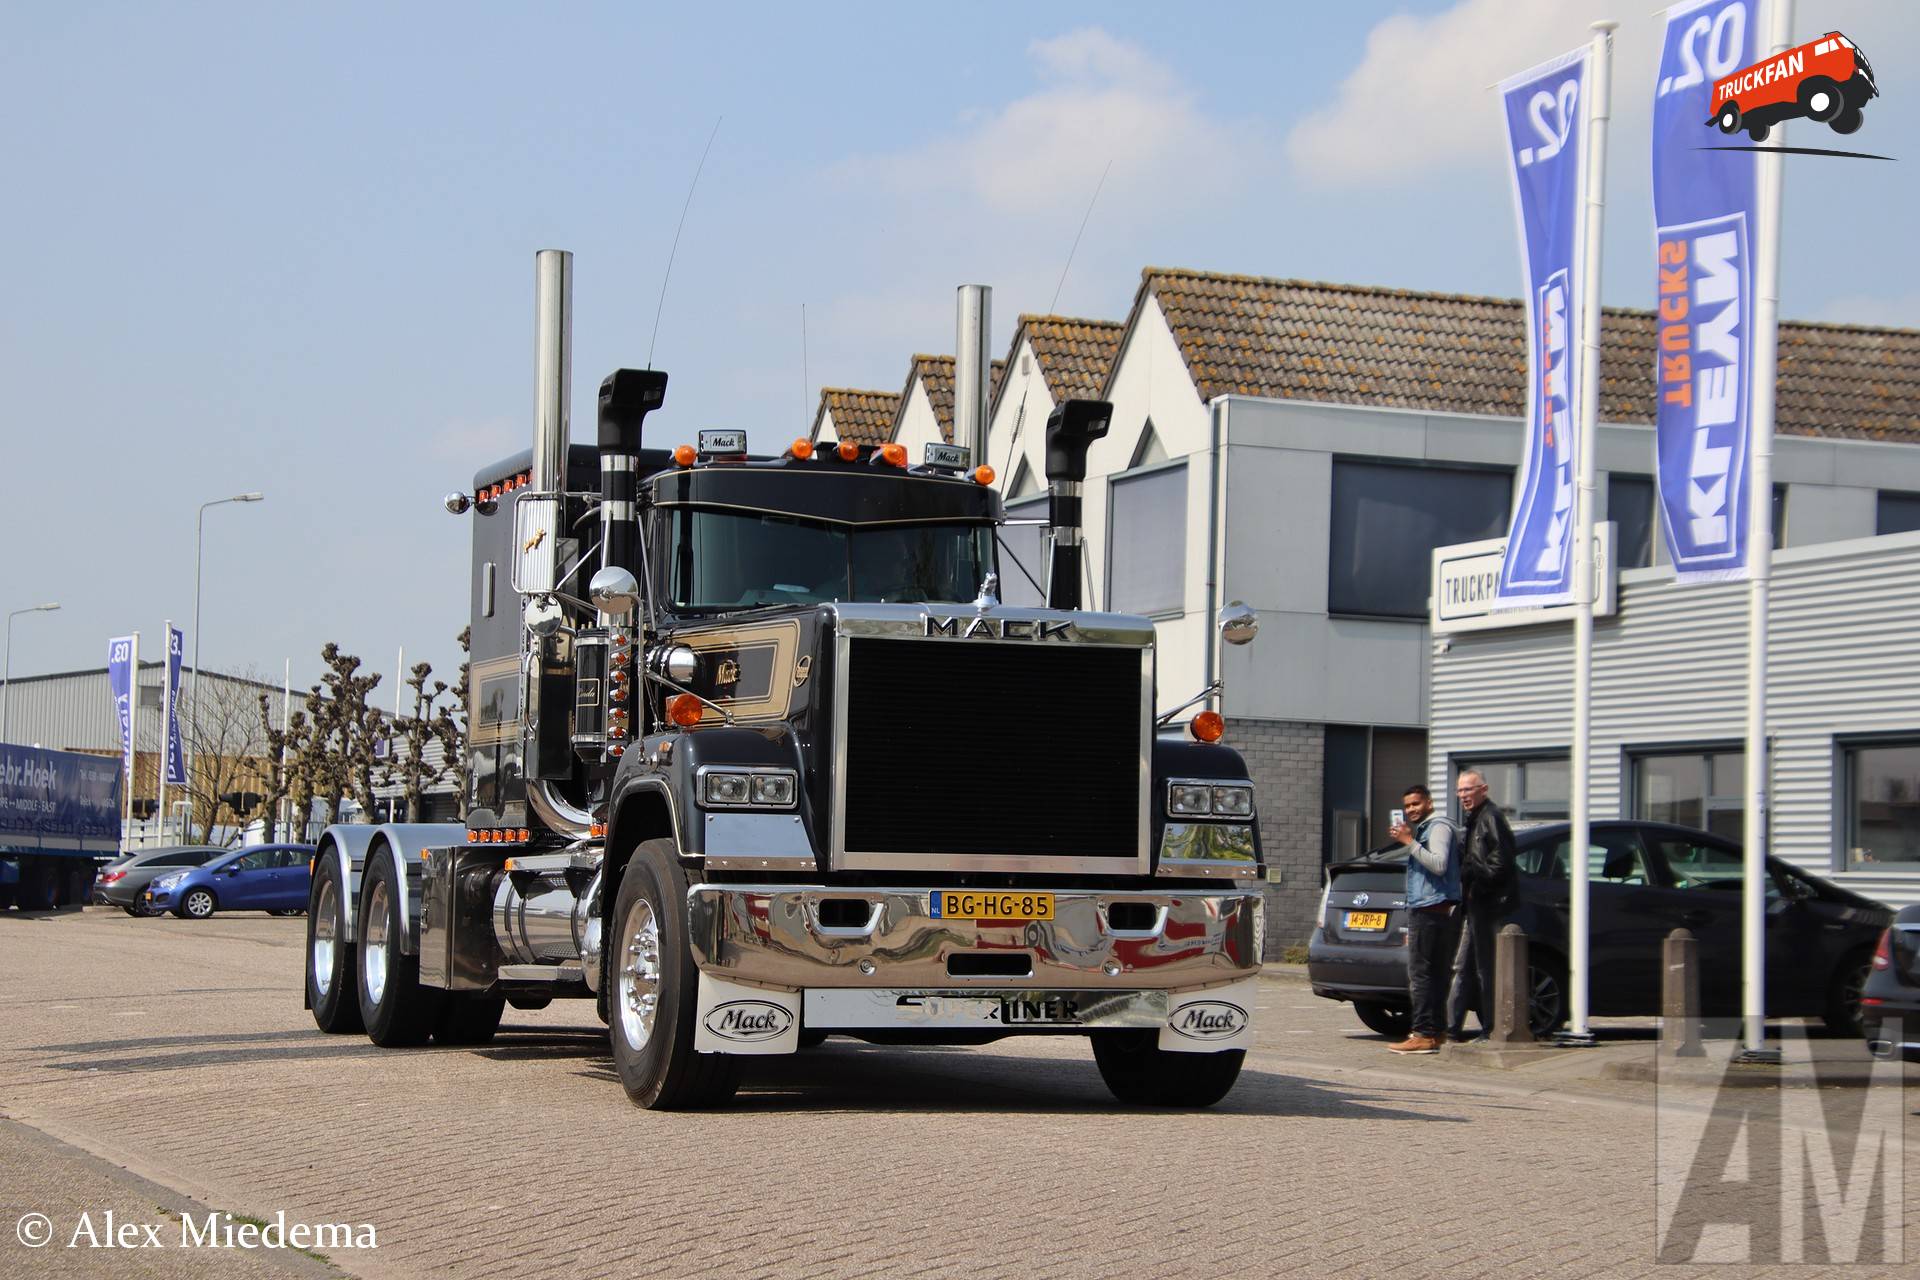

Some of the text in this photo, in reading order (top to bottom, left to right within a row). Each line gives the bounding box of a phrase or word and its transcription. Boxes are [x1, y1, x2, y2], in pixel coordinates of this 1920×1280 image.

[712, 436, 736, 448] Mack
[936, 452, 960, 463] Mack
[924, 615, 1075, 641] MACK
[947, 895, 1048, 916] BG-HG-85
[718, 1008, 779, 1034] Mack
[1181, 1009, 1236, 1033] Mack
